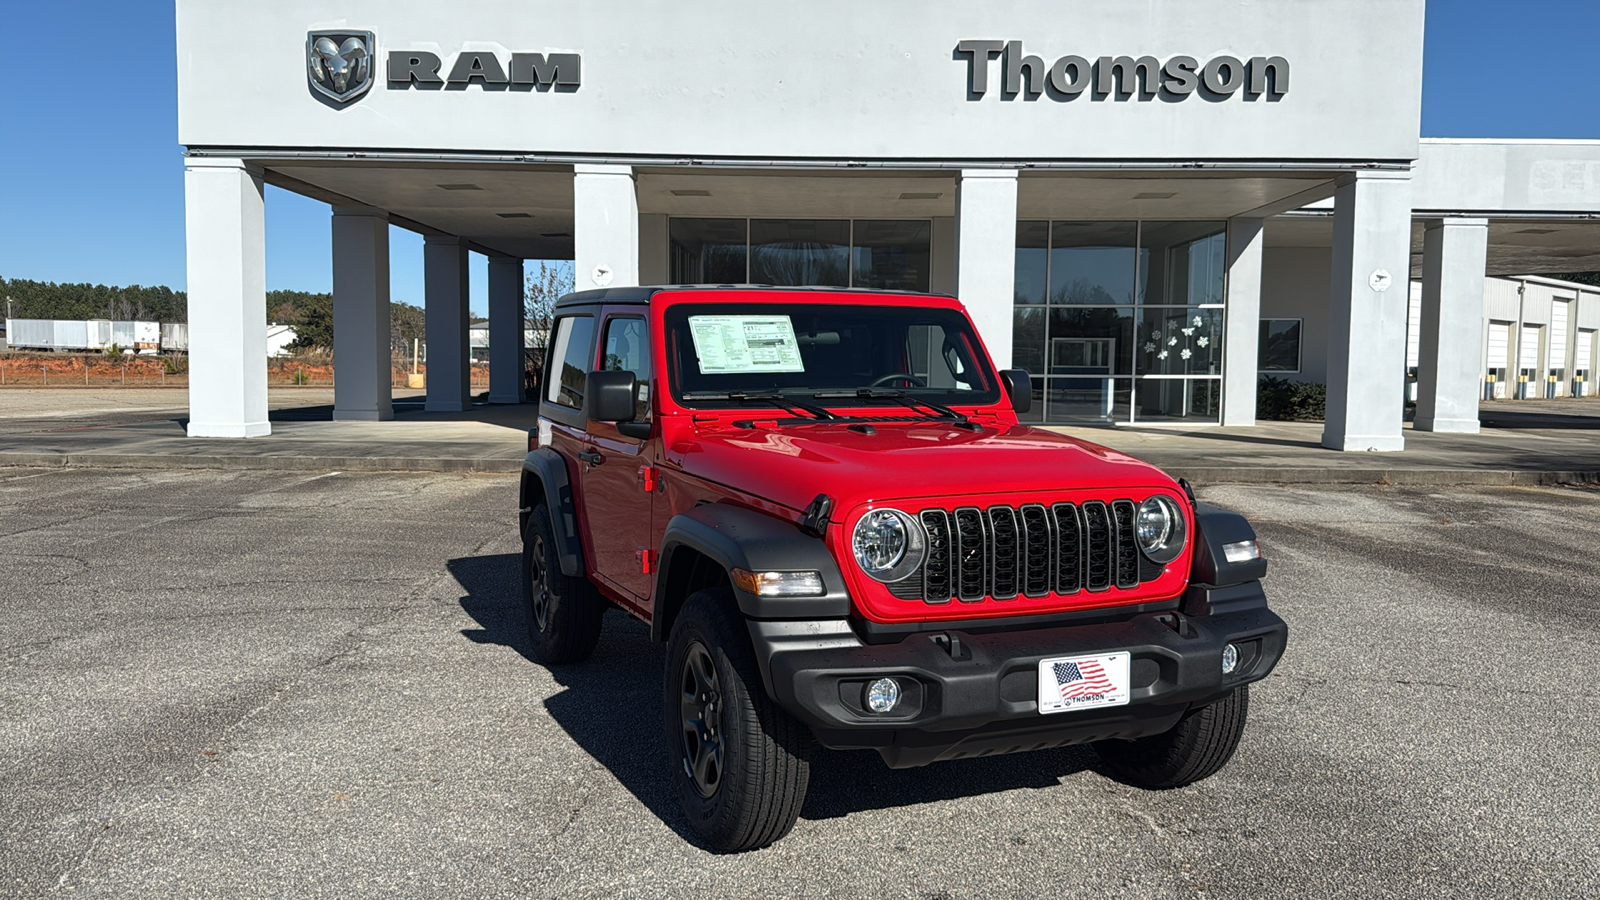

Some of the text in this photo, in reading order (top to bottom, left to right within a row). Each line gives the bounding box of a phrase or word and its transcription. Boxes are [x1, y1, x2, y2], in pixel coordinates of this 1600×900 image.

[388, 51, 581, 90] RAM
[956, 40, 1290, 100] Thomson
[1072, 694, 1105, 703] THOMSON
